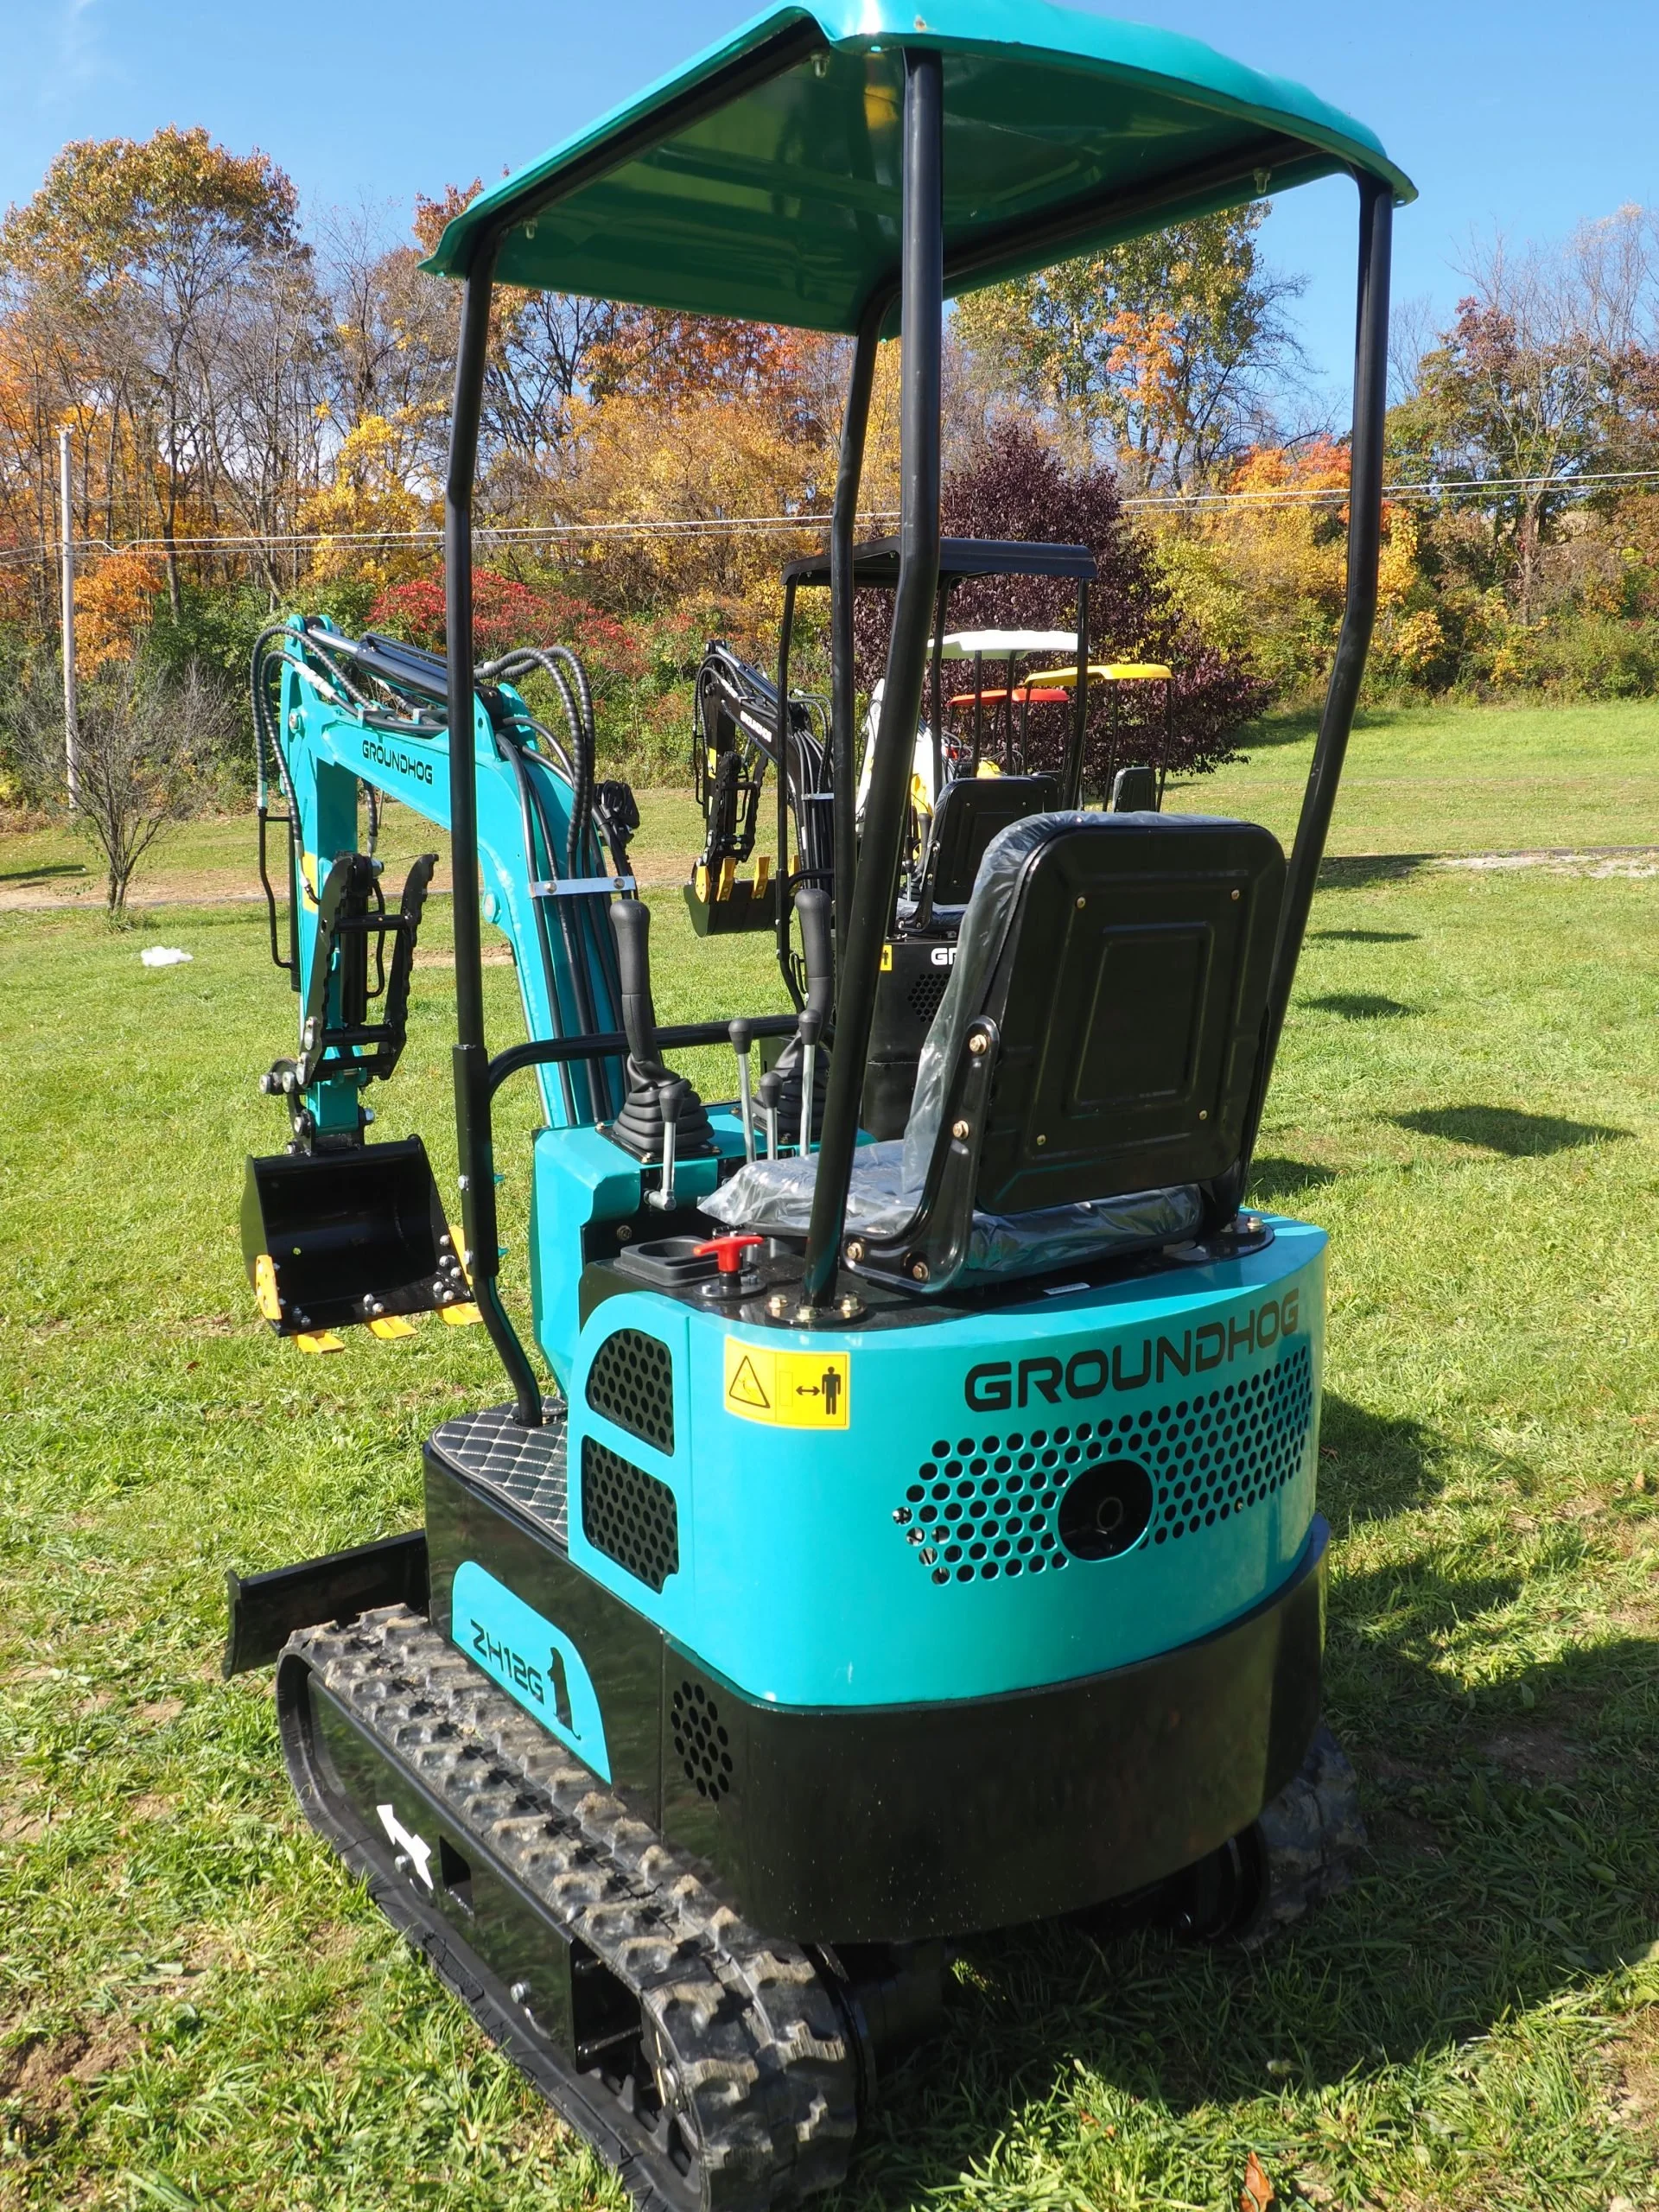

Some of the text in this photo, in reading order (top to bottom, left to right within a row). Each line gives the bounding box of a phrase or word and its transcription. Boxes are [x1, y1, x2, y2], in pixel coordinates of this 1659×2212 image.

[362, 739, 433, 785] GROUNDHOG
[963, 1287, 1300, 1413] GROUNDHOG
[470, 1618, 544, 1705] ZH12G
